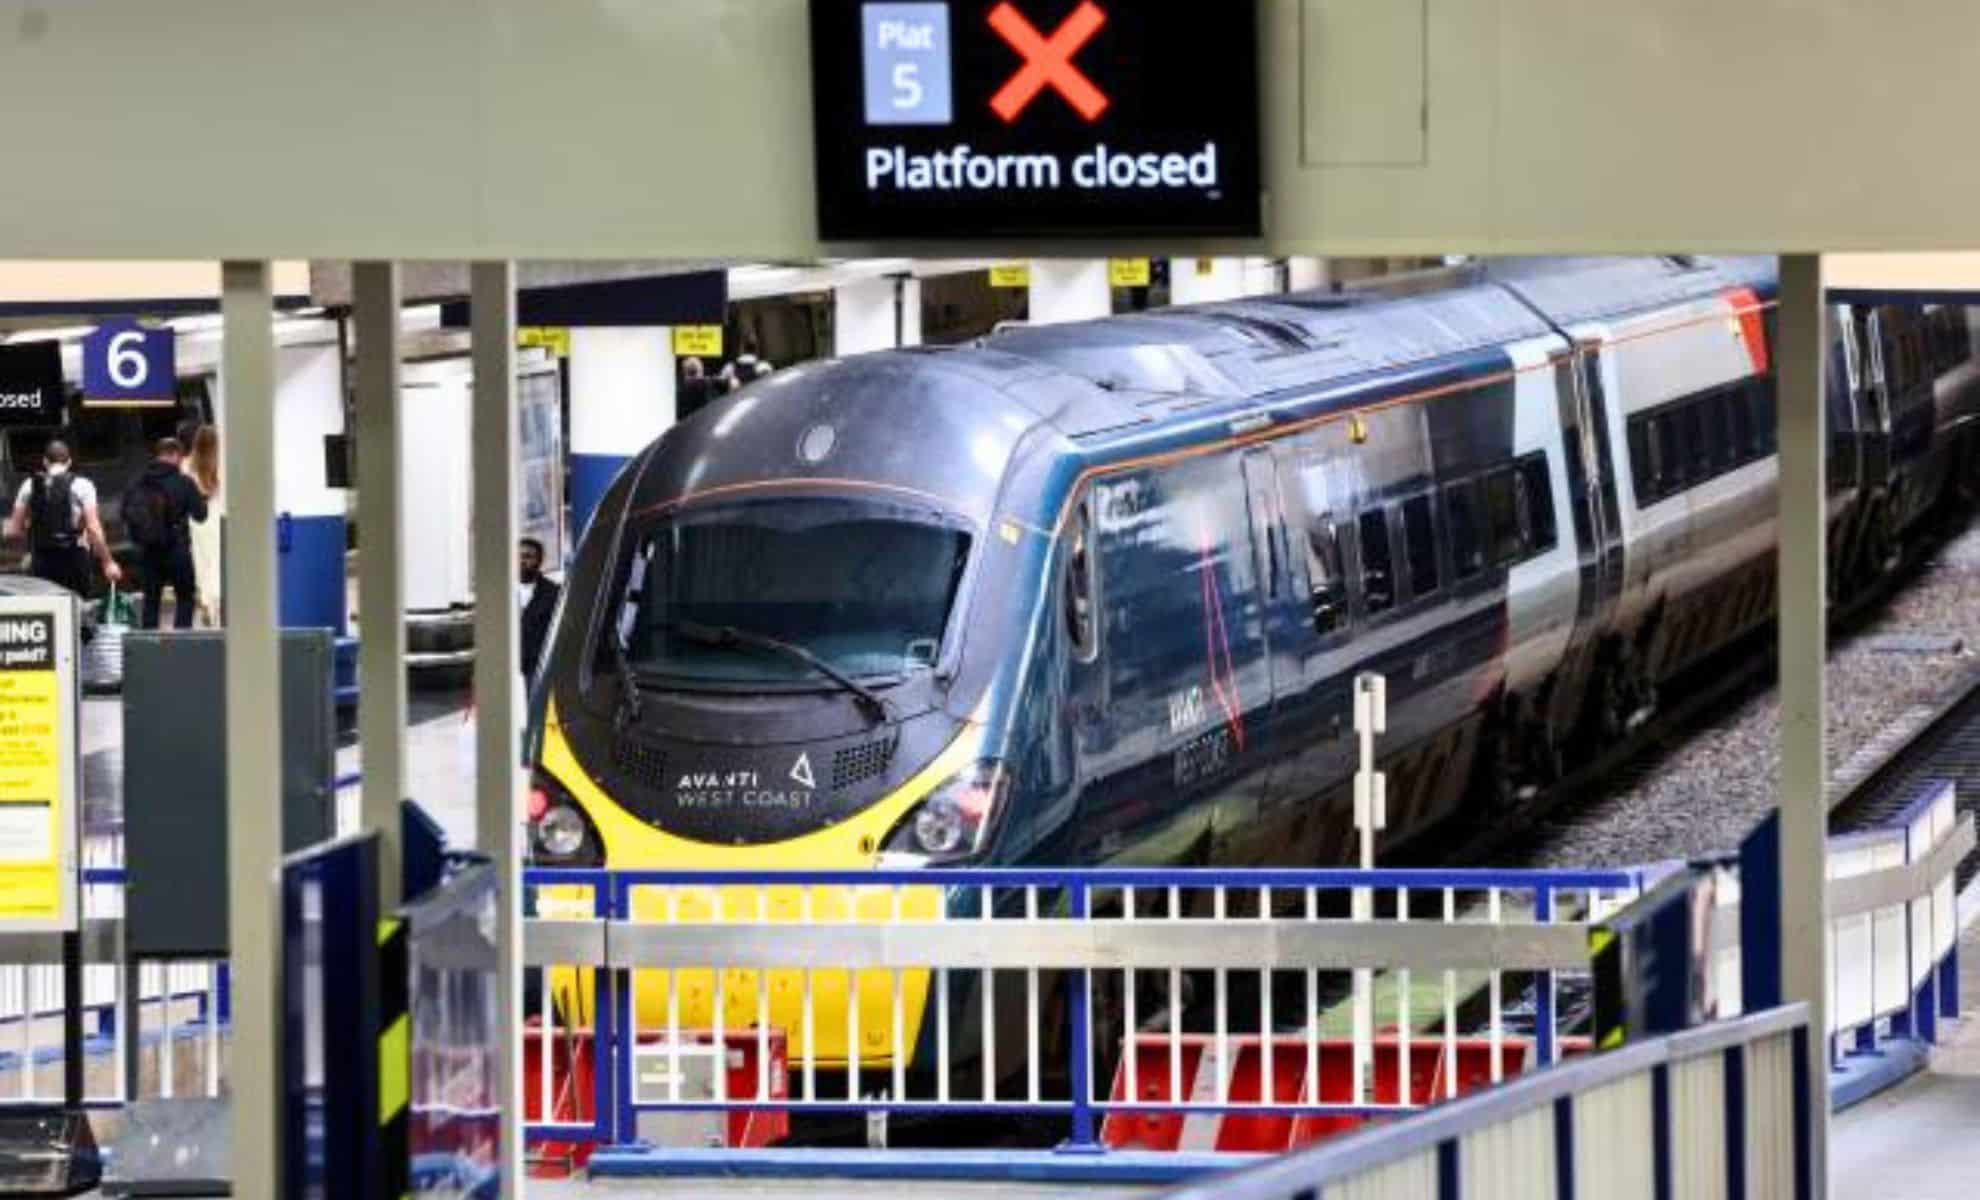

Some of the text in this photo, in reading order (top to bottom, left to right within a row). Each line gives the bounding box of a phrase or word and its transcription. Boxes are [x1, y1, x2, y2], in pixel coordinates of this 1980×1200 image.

[878, 22, 934, 49] Plat
[891, 64, 922, 109] 5
[865, 143, 1217, 190] Platform closed
[107, 331, 148, 388] 6
[676, 790, 813, 809] WEST COAST
